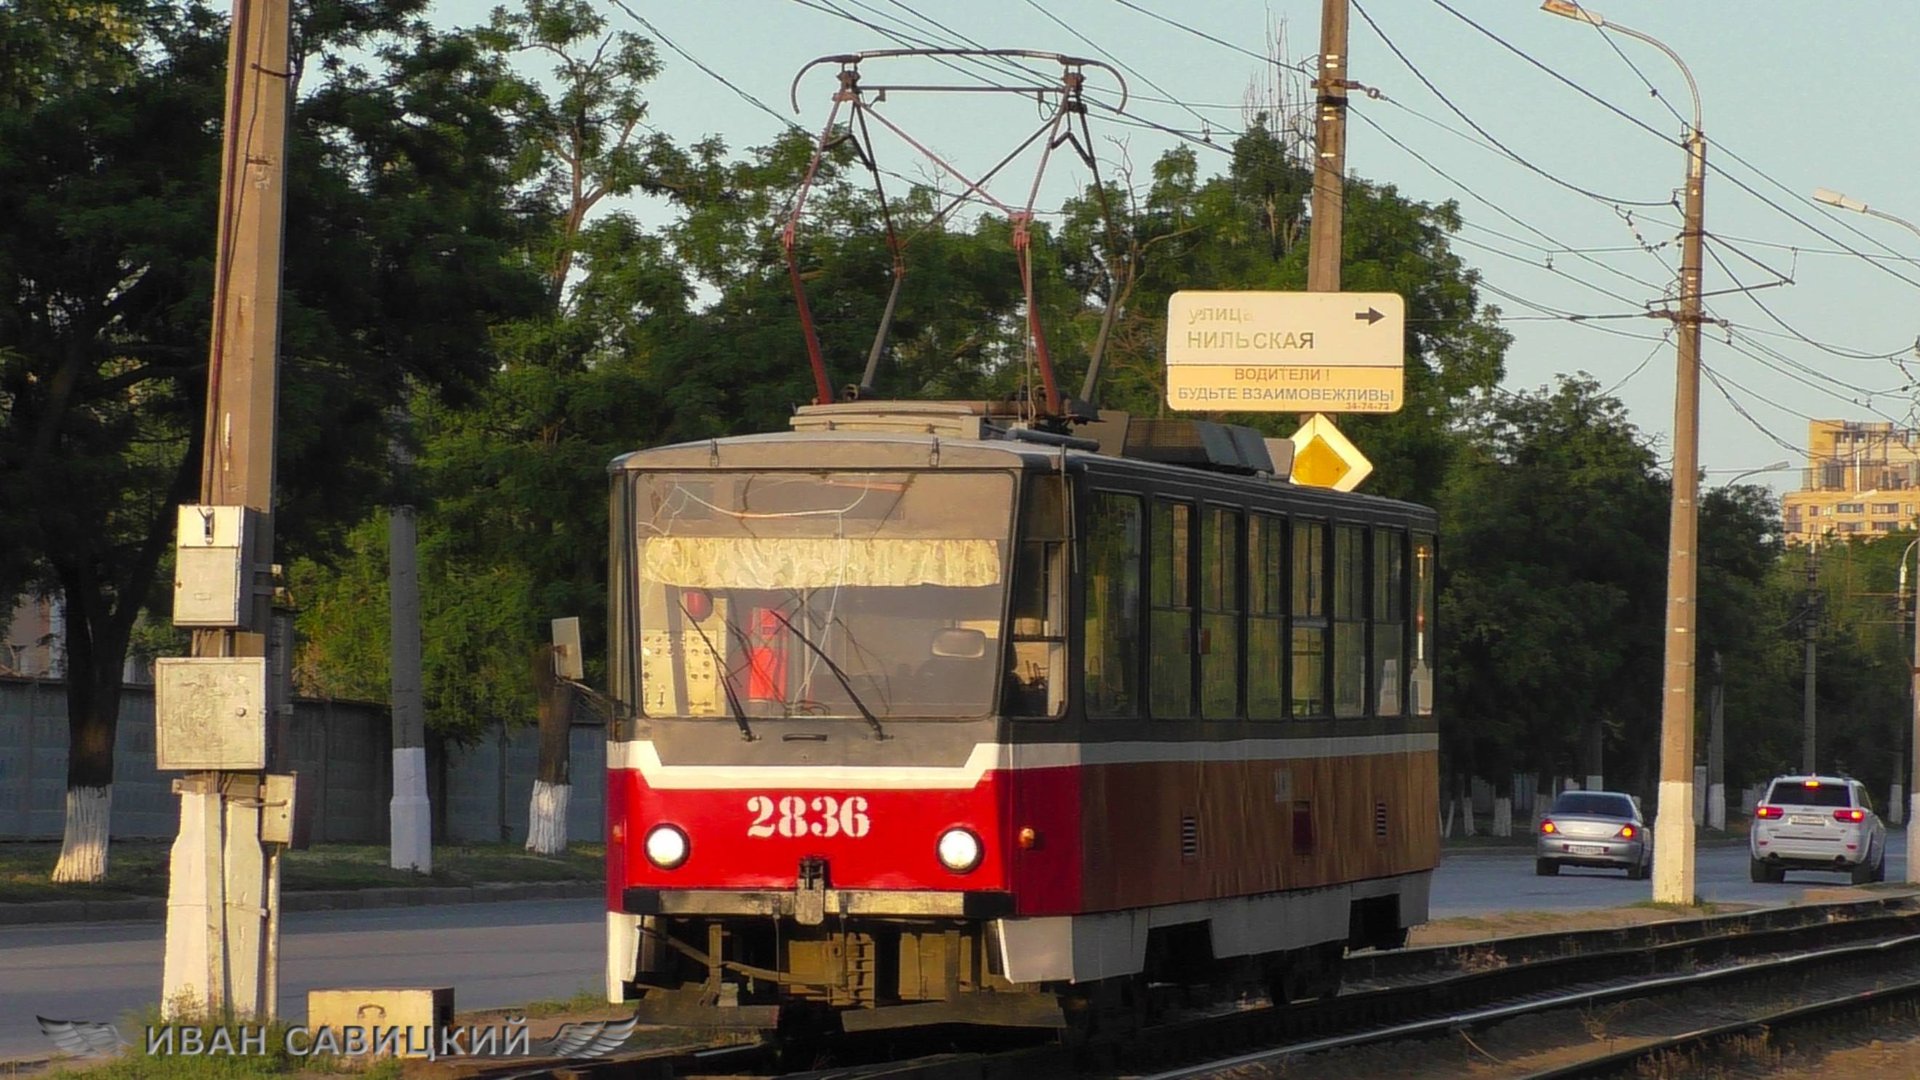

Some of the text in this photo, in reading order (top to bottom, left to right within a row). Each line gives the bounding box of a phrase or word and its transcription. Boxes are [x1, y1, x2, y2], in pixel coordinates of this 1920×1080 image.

[1187, 331, 1314, 349] НИЛЬСКАЯ
[1234, 368, 1321, 382] ВОДИТЕЛИ
[1178, 387, 1394, 402] БУДЬТЕ ВЗАИМОВЕЖЛИВЫ
[747, 796, 870, 838] 2836
